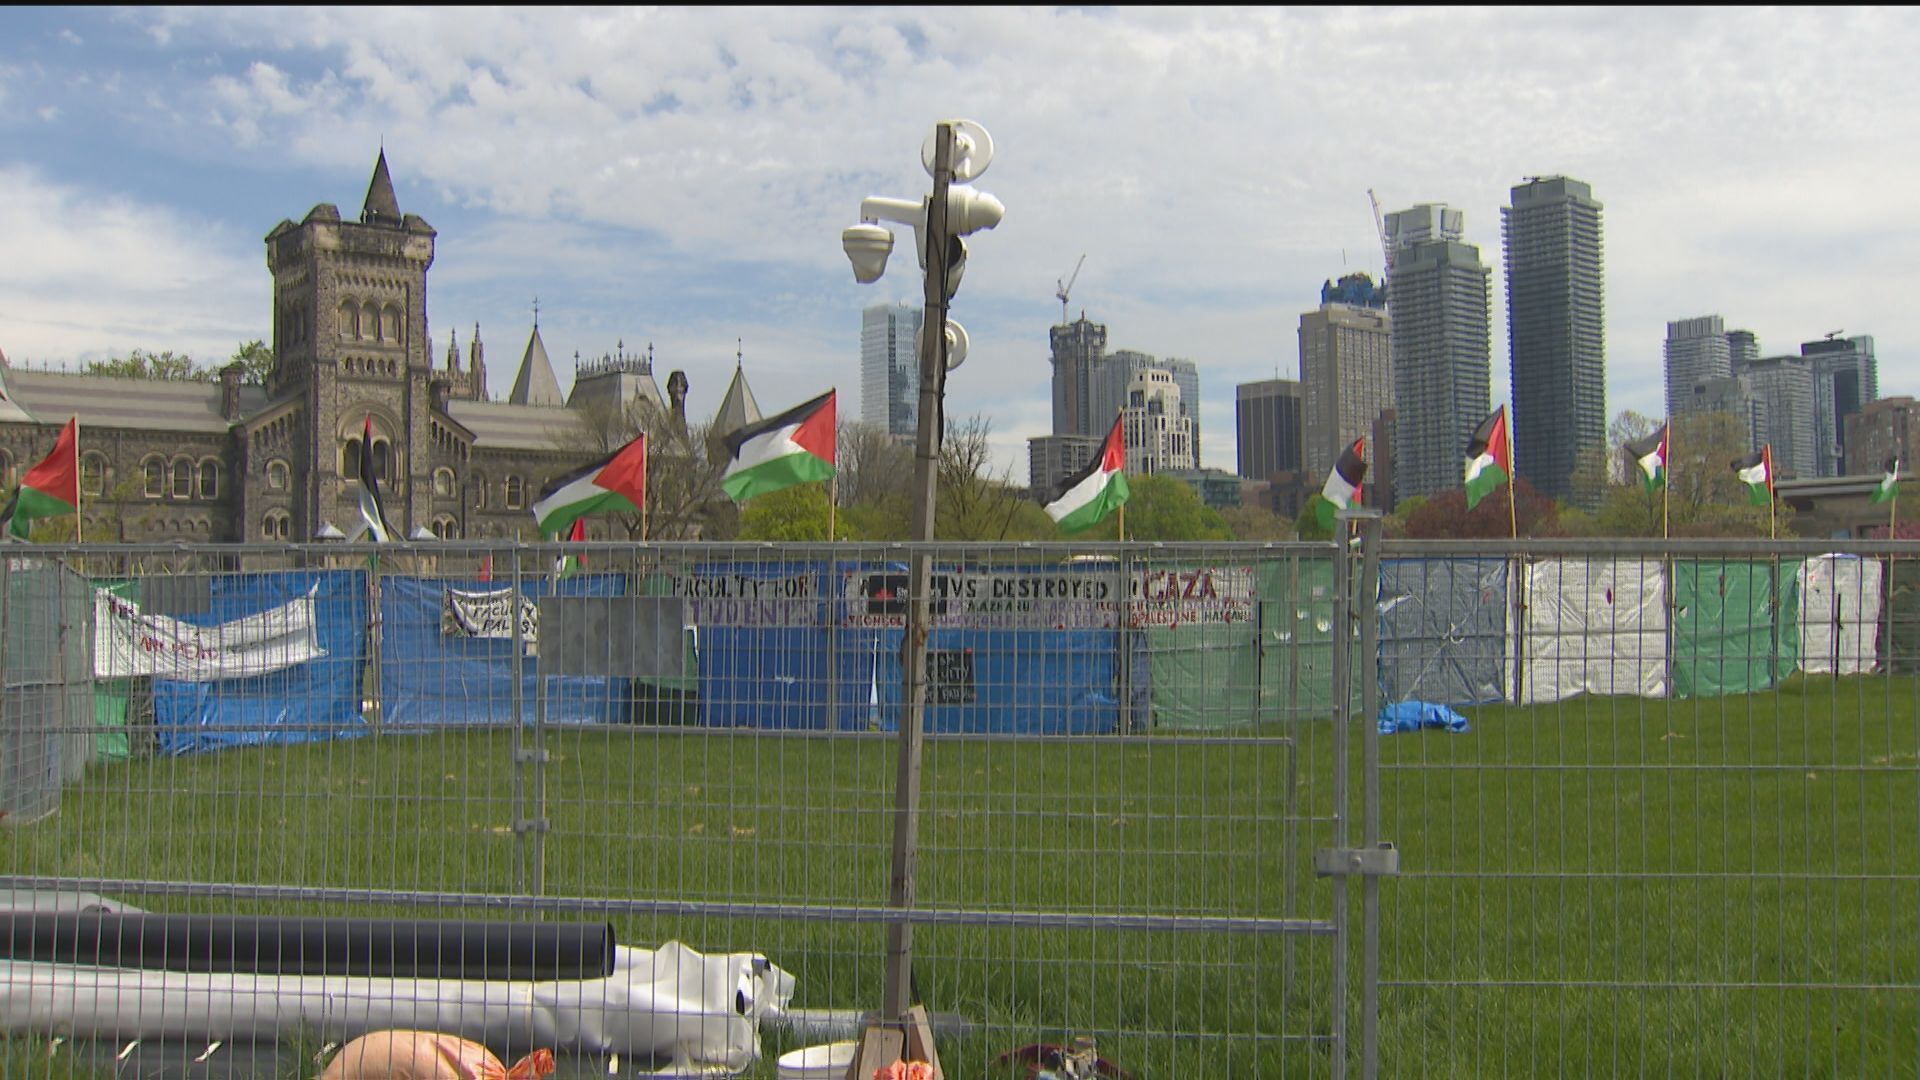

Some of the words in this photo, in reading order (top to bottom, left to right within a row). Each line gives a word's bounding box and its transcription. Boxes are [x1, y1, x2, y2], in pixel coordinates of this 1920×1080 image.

[671, 575, 764, 600] FACULTY
[993, 578, 1108, 599] DESTROYED
[1143, 569, 1217, 603] GAZA
[690, 600, 816, 626] TUDENTS
